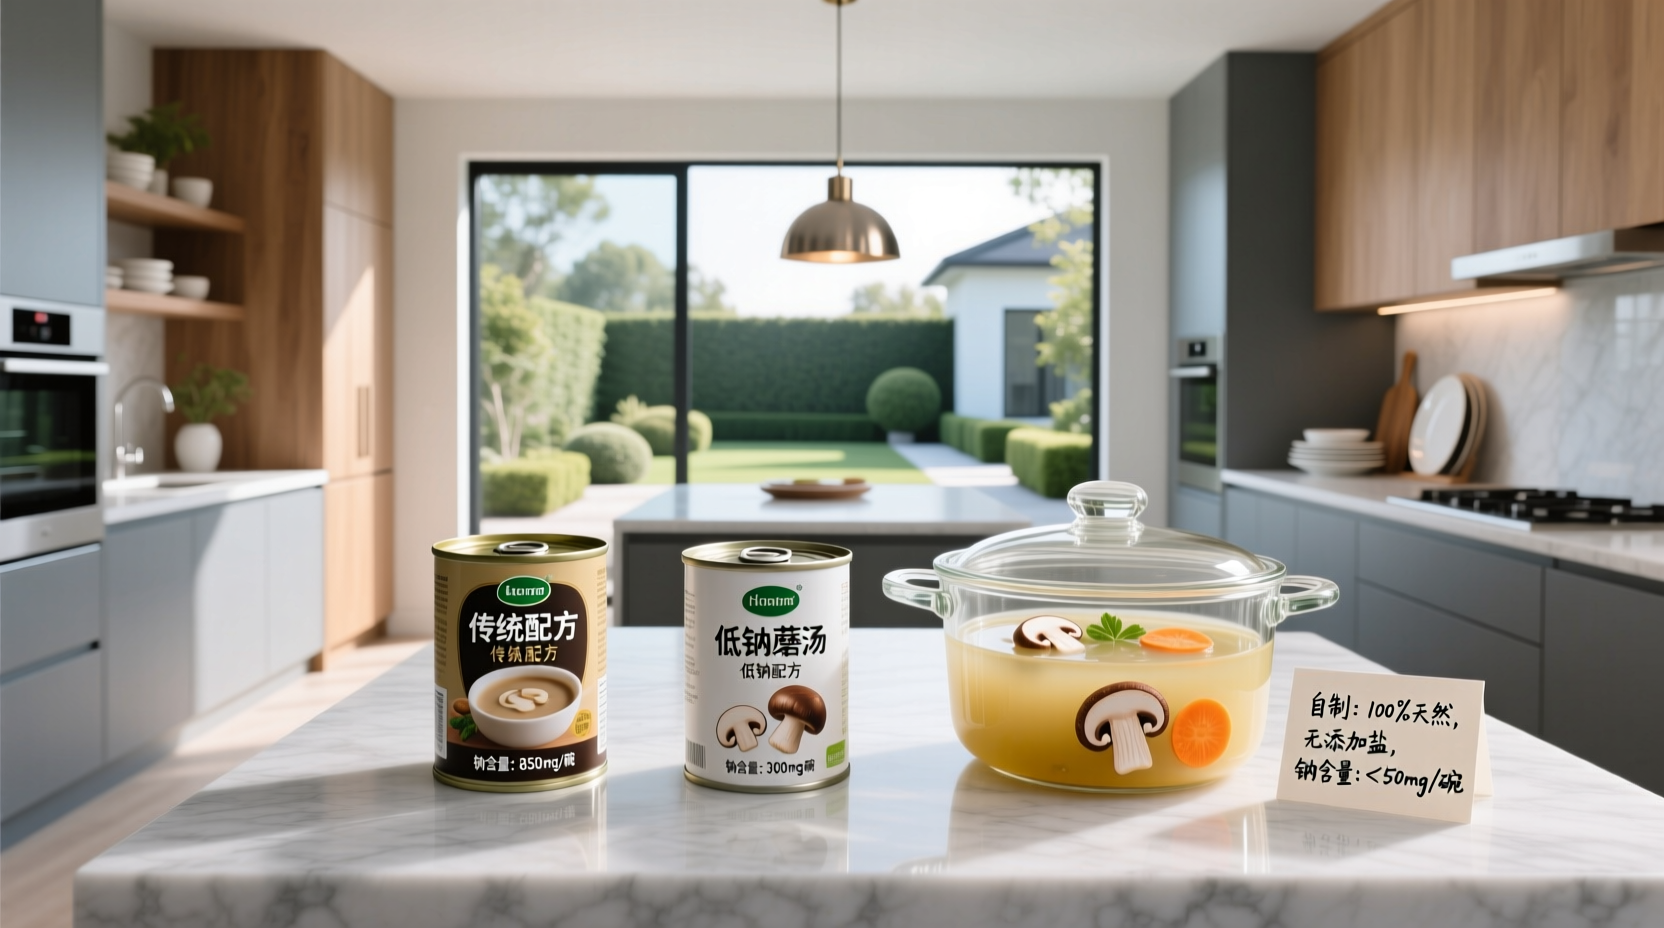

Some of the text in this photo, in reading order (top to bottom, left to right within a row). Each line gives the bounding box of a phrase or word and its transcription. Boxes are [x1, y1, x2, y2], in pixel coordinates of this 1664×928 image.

[469, 611, 578, 643] 传统配方
[715, 625, 826, 657] 低钠蘑汤
